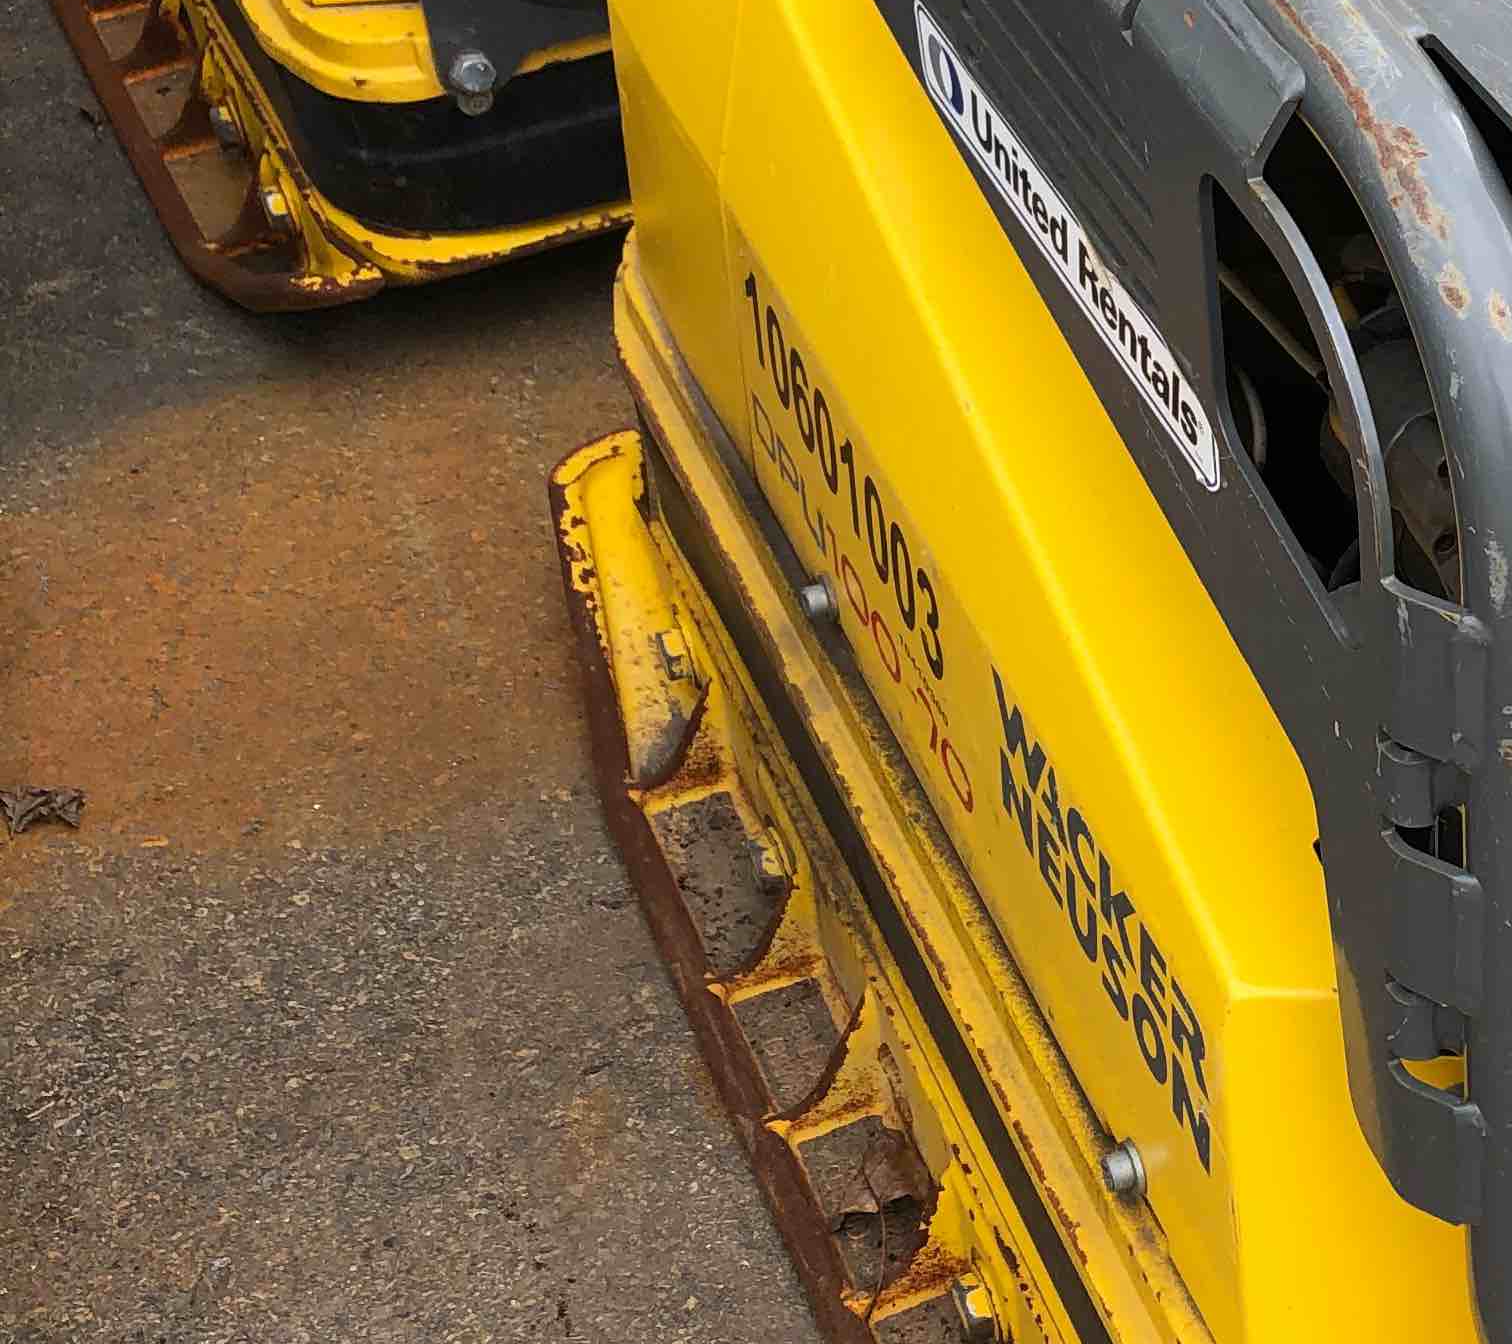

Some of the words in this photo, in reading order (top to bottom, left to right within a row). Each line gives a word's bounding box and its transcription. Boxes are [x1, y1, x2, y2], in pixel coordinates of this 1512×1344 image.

[744, 272, 944, 681] 10601003
[969, 89, 1069, 269] United
[1077, 237, 1200, 447] Rentals
[991, 664, 1210, 1104] WACKER
[999, 747, 1211, 1177] NEUSON
